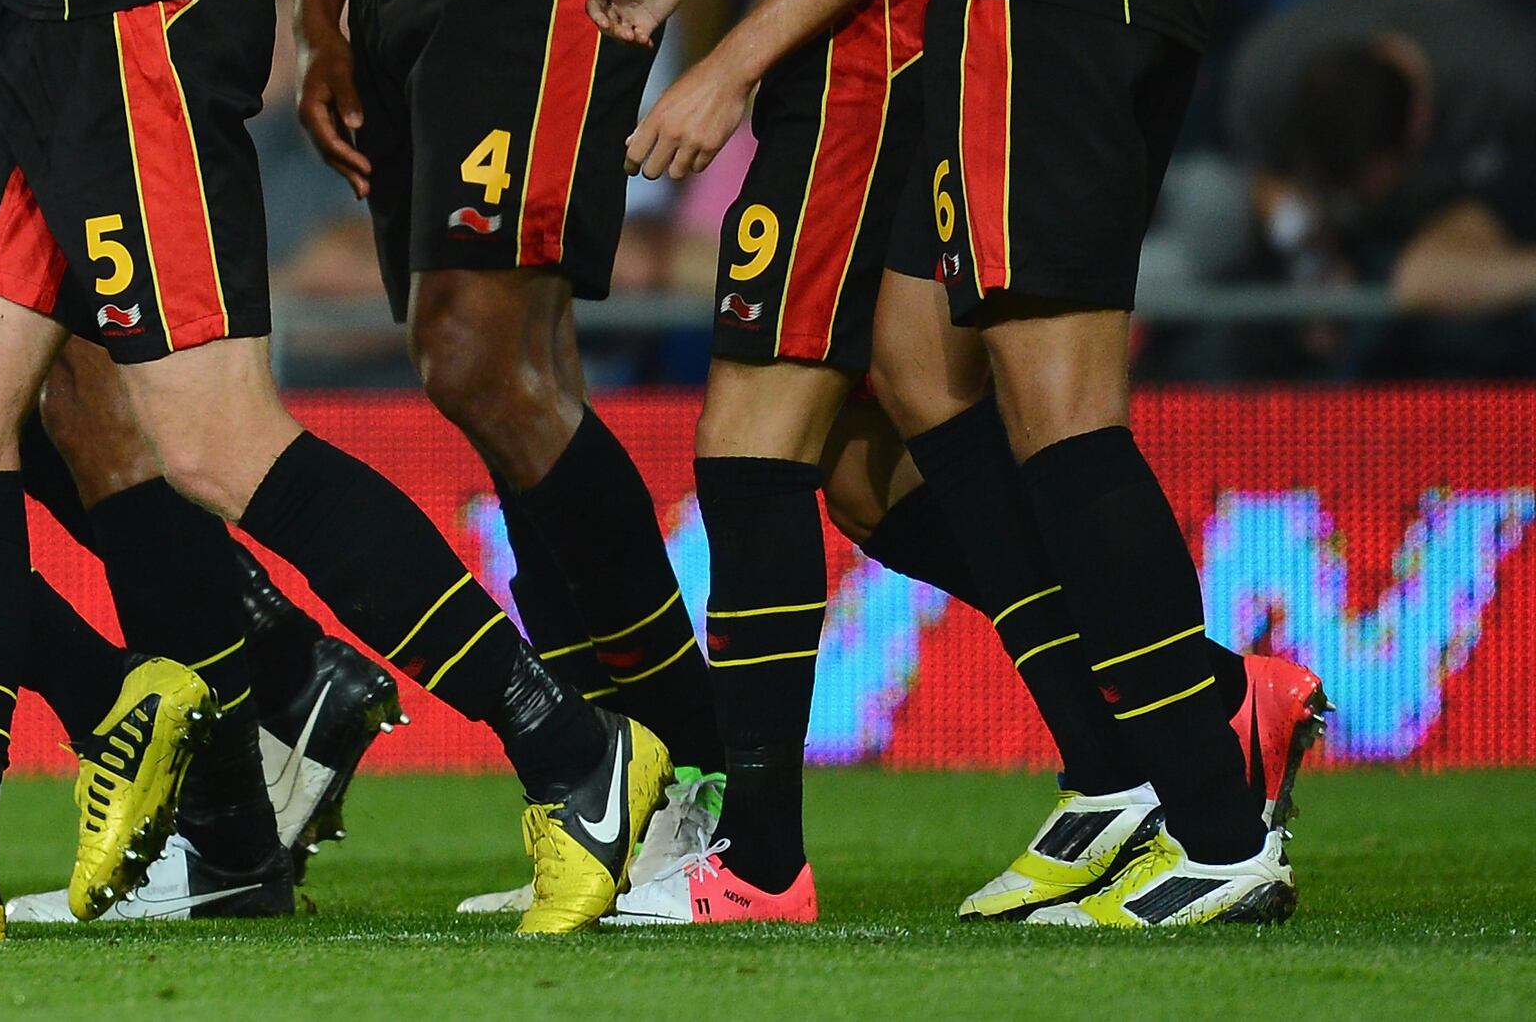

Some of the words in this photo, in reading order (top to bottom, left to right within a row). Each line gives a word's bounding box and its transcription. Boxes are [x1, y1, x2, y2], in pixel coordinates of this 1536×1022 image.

[461, 129, 511, 204] 4
[934, 159, 955, 242] 6
[85, 213, 134, 296] 5
[729, 204, 779, 281] 9
[694, 898, 710, 915] 11
[723, 889, 752, 908] KEVIN
